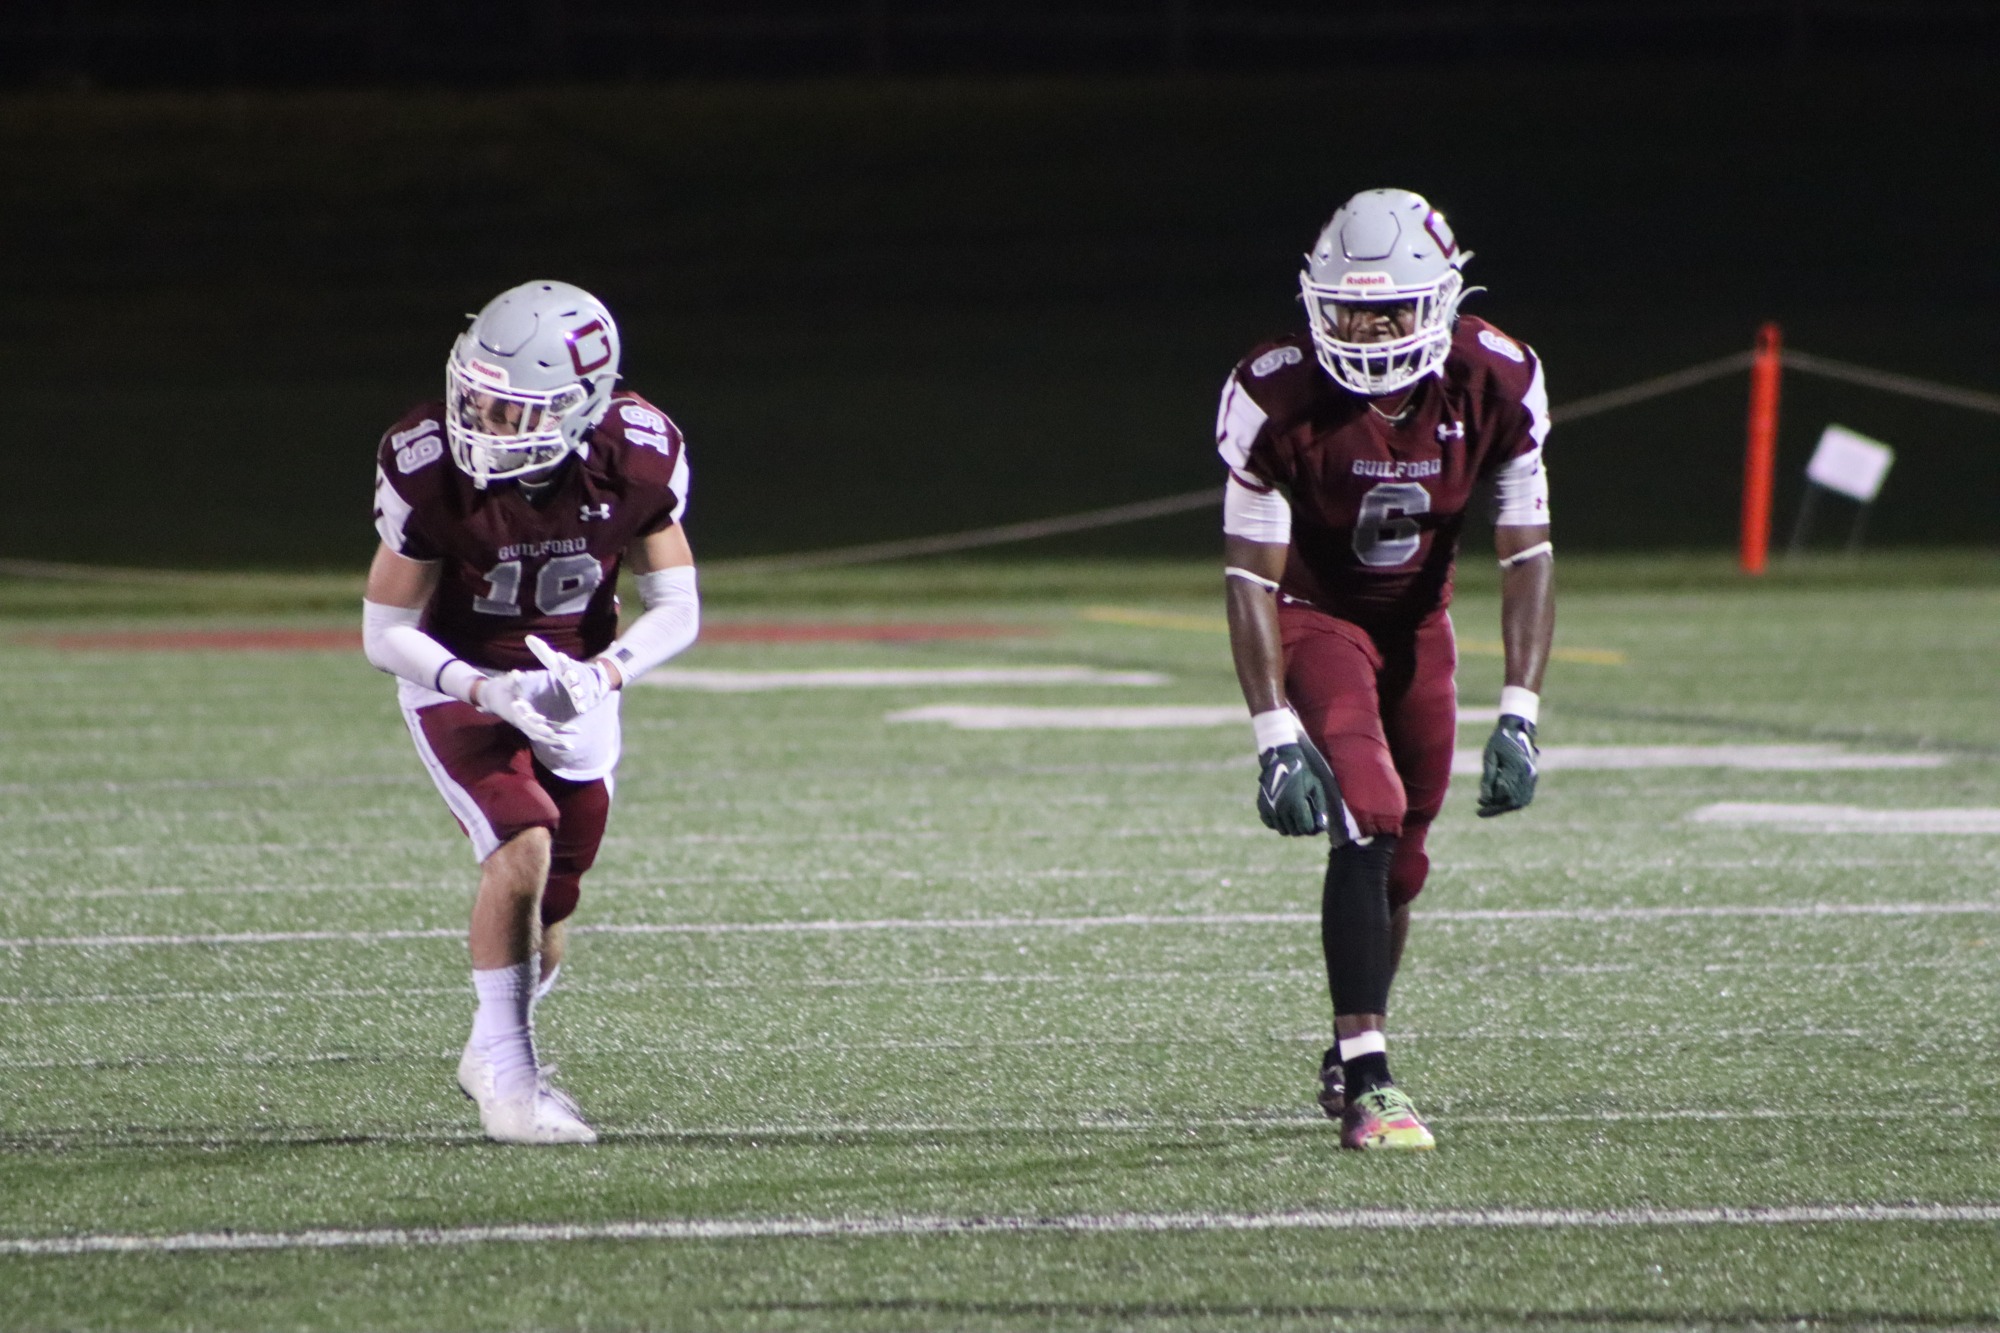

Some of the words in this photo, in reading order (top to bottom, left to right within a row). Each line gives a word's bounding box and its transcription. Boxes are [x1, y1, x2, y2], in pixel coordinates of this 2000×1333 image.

[1346, 276, 1386, 286] Riddell
[1251, 346, 1303, 377] 6
[1477, 330, 1524, 363] 6
[619, 405, 669, 456] 19
[391, 419, 443, 475] 19
[1352, 458, 1441, 478] GUILFORD
[1352, 482, 1431, 566] 6
[497, 536, 587, 560] GUILFORD
